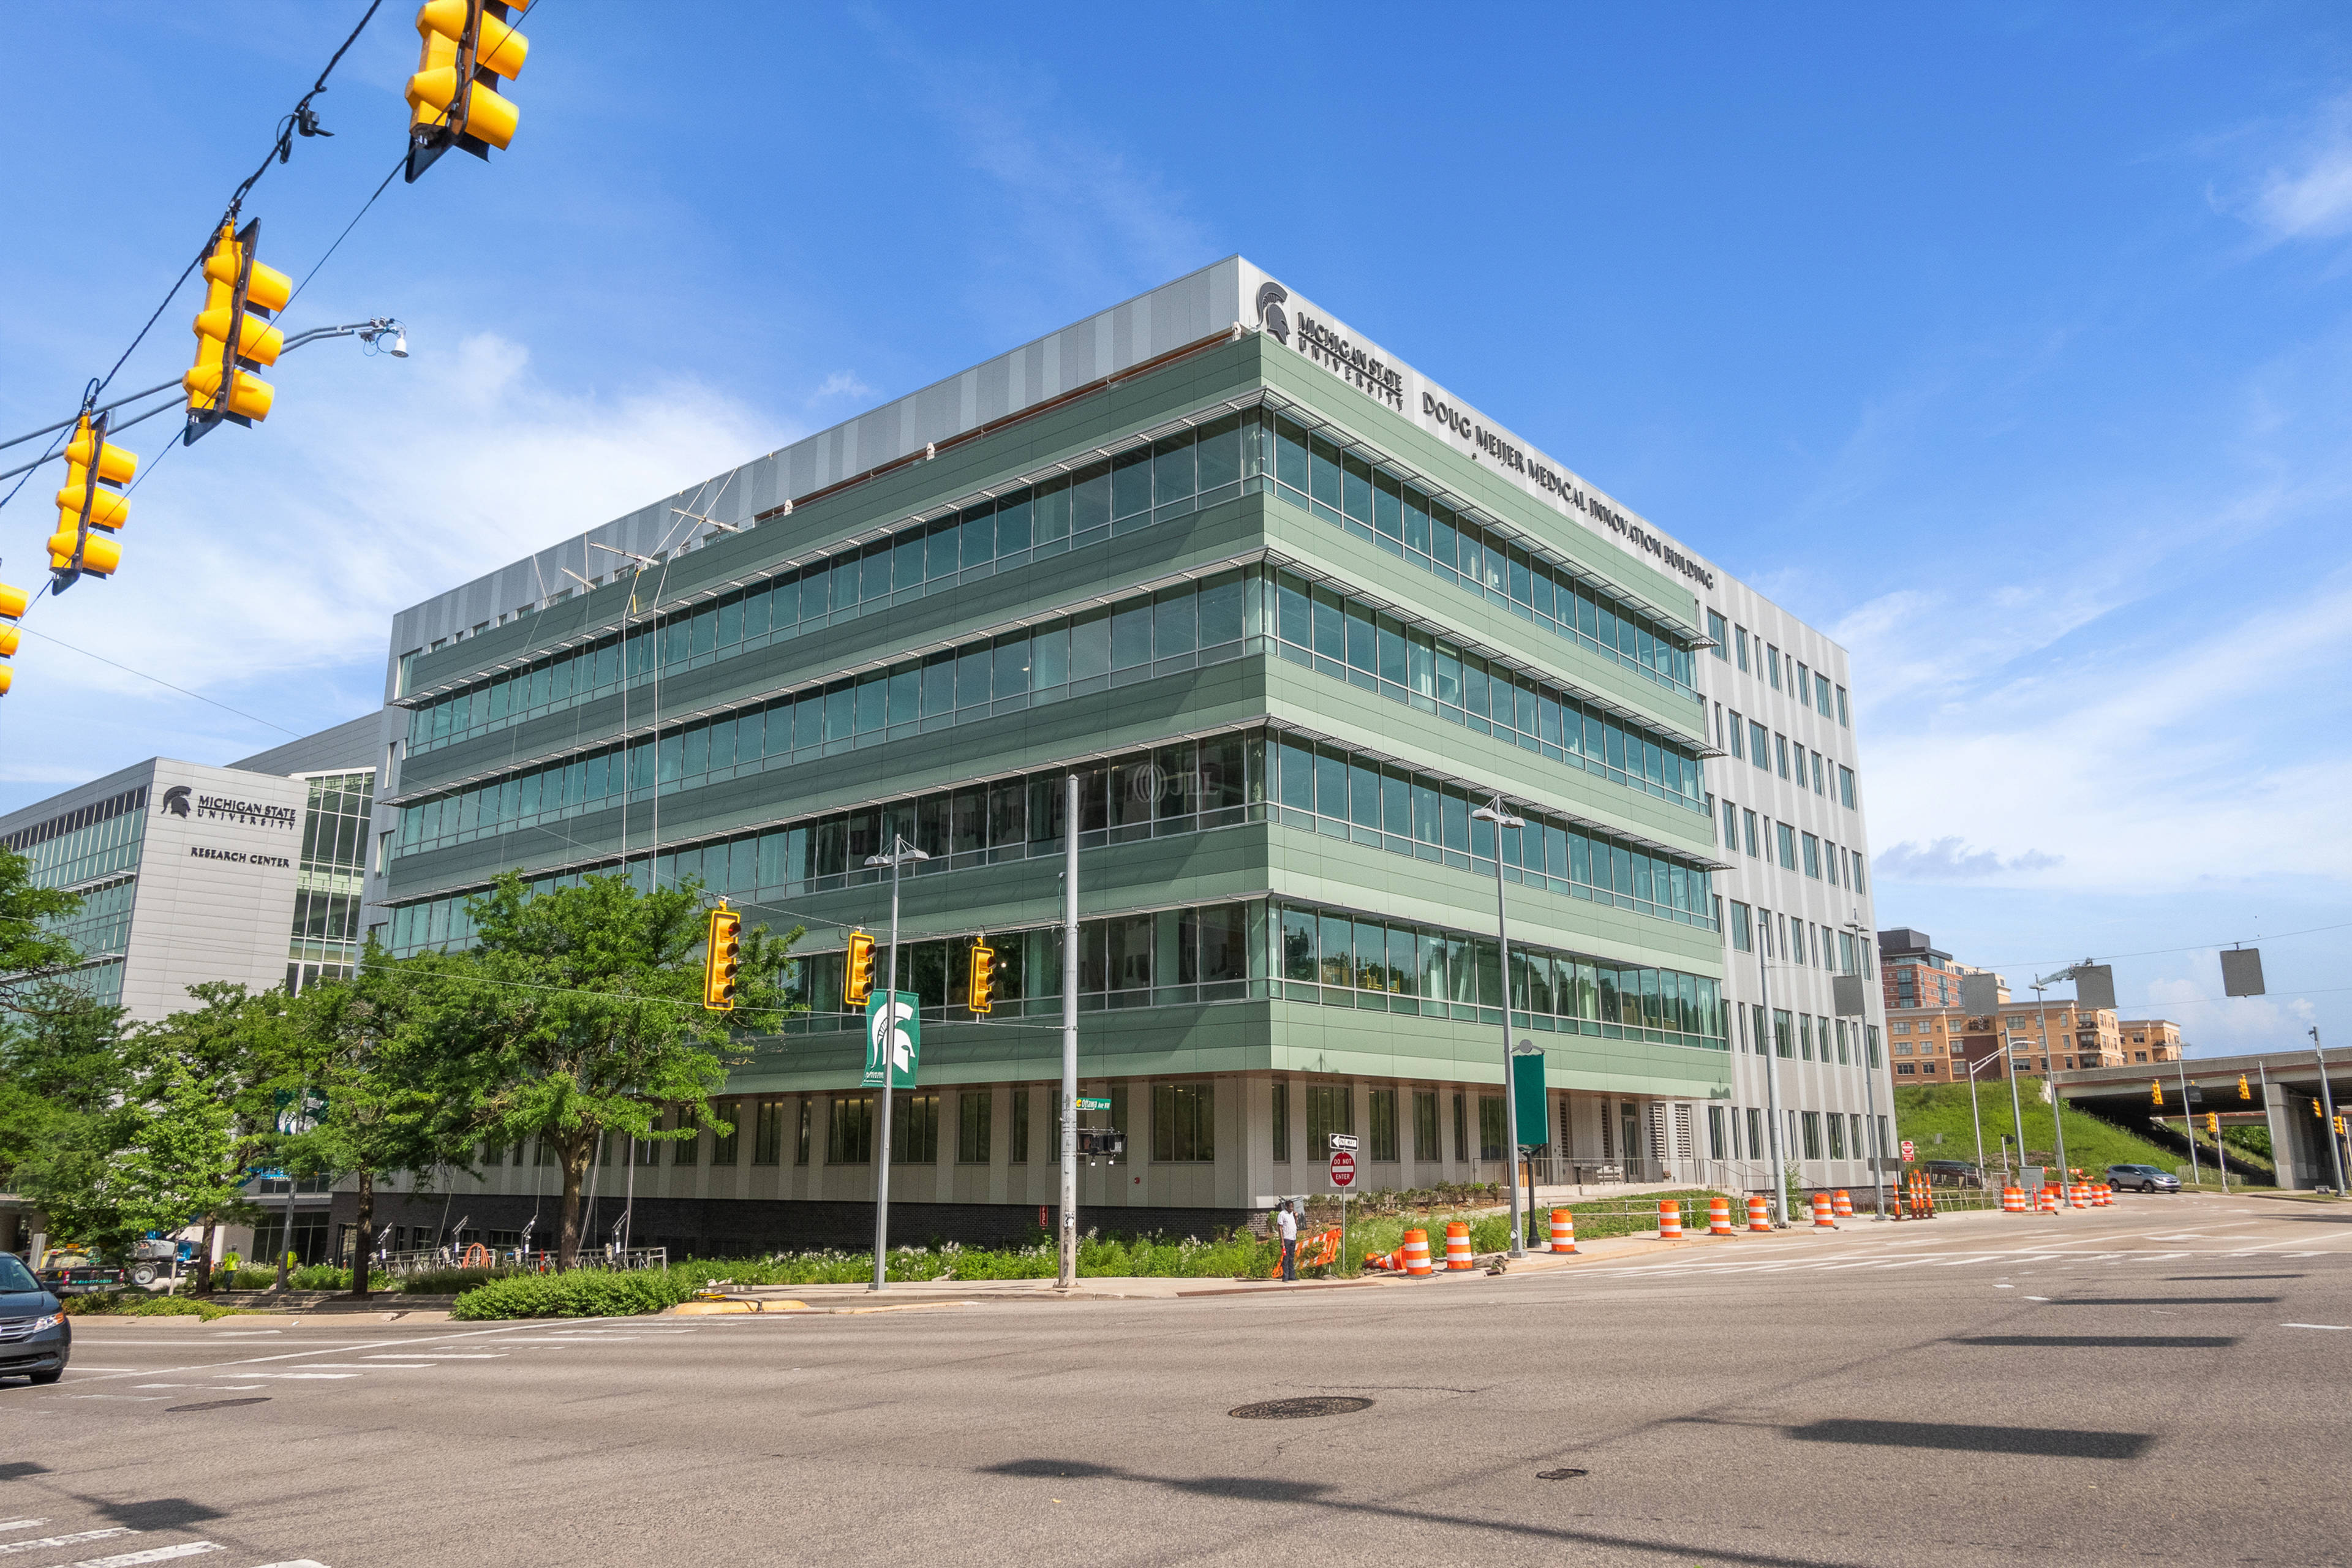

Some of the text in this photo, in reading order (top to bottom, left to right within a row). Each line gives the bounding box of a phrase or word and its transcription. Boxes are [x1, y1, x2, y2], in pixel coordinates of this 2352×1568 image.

[1298, 312, 1403, 392] MICHIGAN STATE
[1298, 337, 1403, 412] UNIVERSITY
[1422, 391, 1714, 589] DOUG MEIJER MEDICAL INNOVATION BUILDING
[198, 795, 296, 819] MICHIGAN STATE
[198, 809, 295, 830] UNIVERSITY
[191, 847, 290, 868] RESEARCH CENTER
[1082, 1099, 1098, 1108] Ottawa
